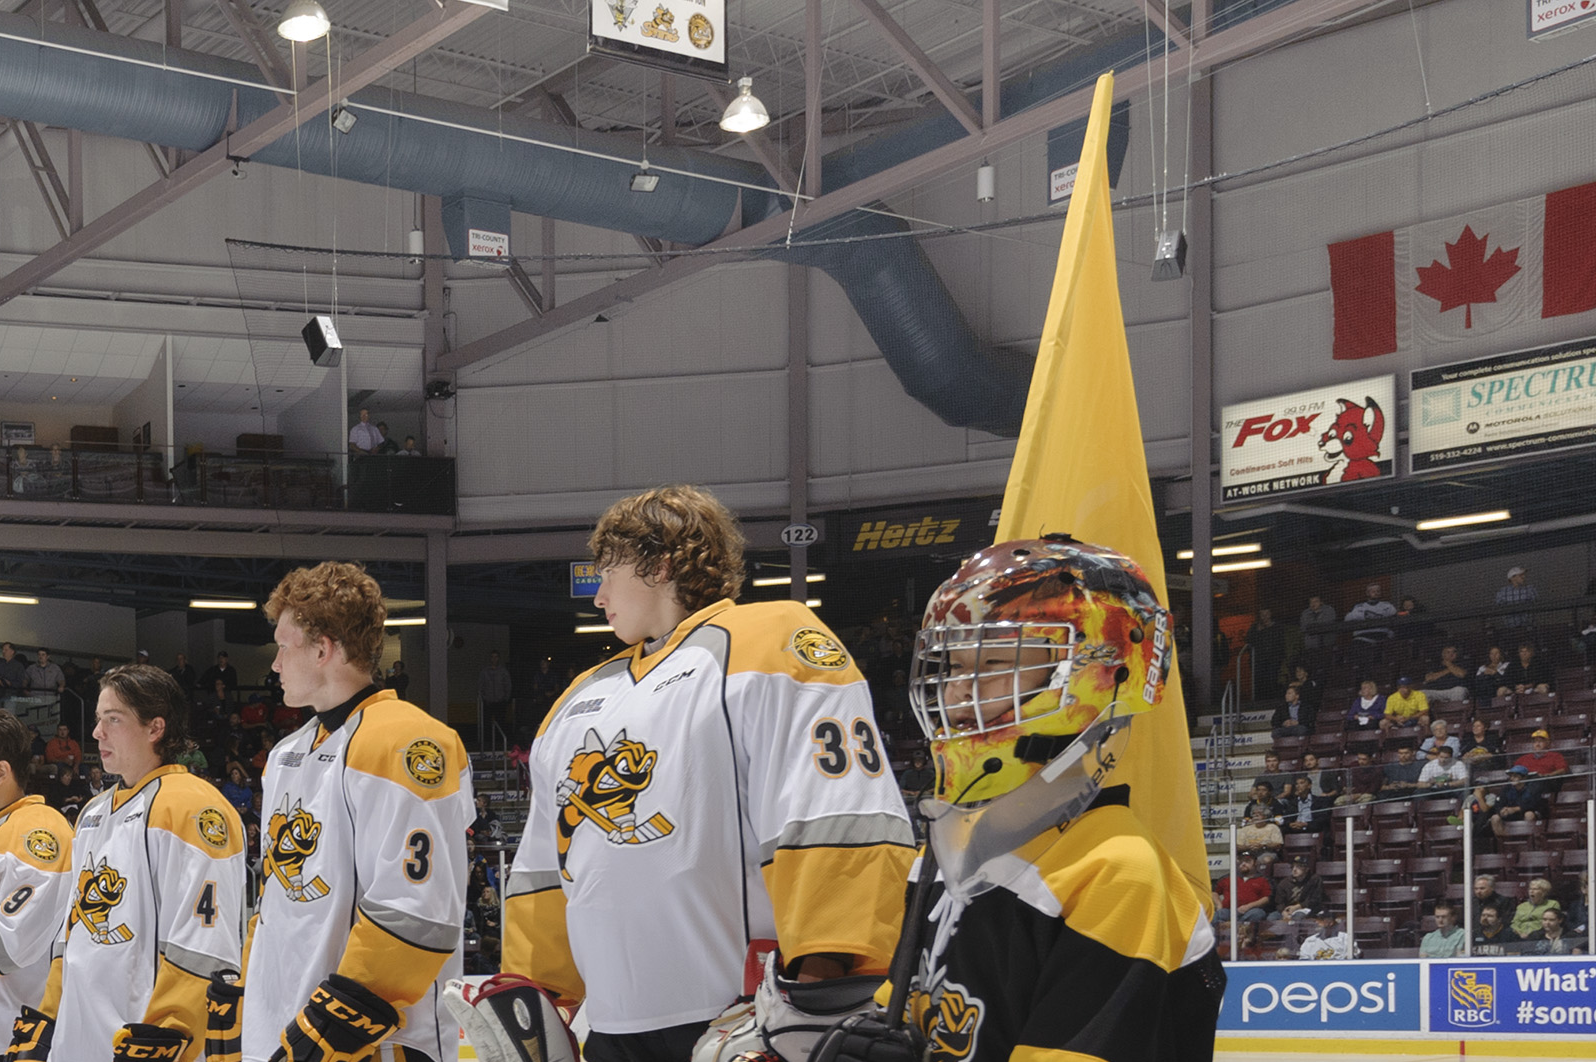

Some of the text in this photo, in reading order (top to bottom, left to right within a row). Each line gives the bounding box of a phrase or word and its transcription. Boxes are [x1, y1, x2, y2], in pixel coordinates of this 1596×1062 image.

[1537, 2, 1576, 23] xerox
[472, 232, 505, 243] TRI-COUNTY
[472, 244, 495, 254] xerox
[1308, 400, 1326, 411] FM
[1225, 418, 1245, 429] THE
[1226, 475, 1320, 499] AT-WORK NETWORK
[783, 528, 816, 543] 122
[852, 516, 961, 551] Hertz
[653, 667, 697, 692] CCM
[810, 716, 884, 779] 33
[403, 828, 434, 885] 3
[0, 884, 36, 917] 9
[194, 881, 219, 928] 4
[1242, 972, 1396, 1022] pepsi
[310, 987, 386, 1035] CCM
[1453, 1009, 1492, 1023] RBC
